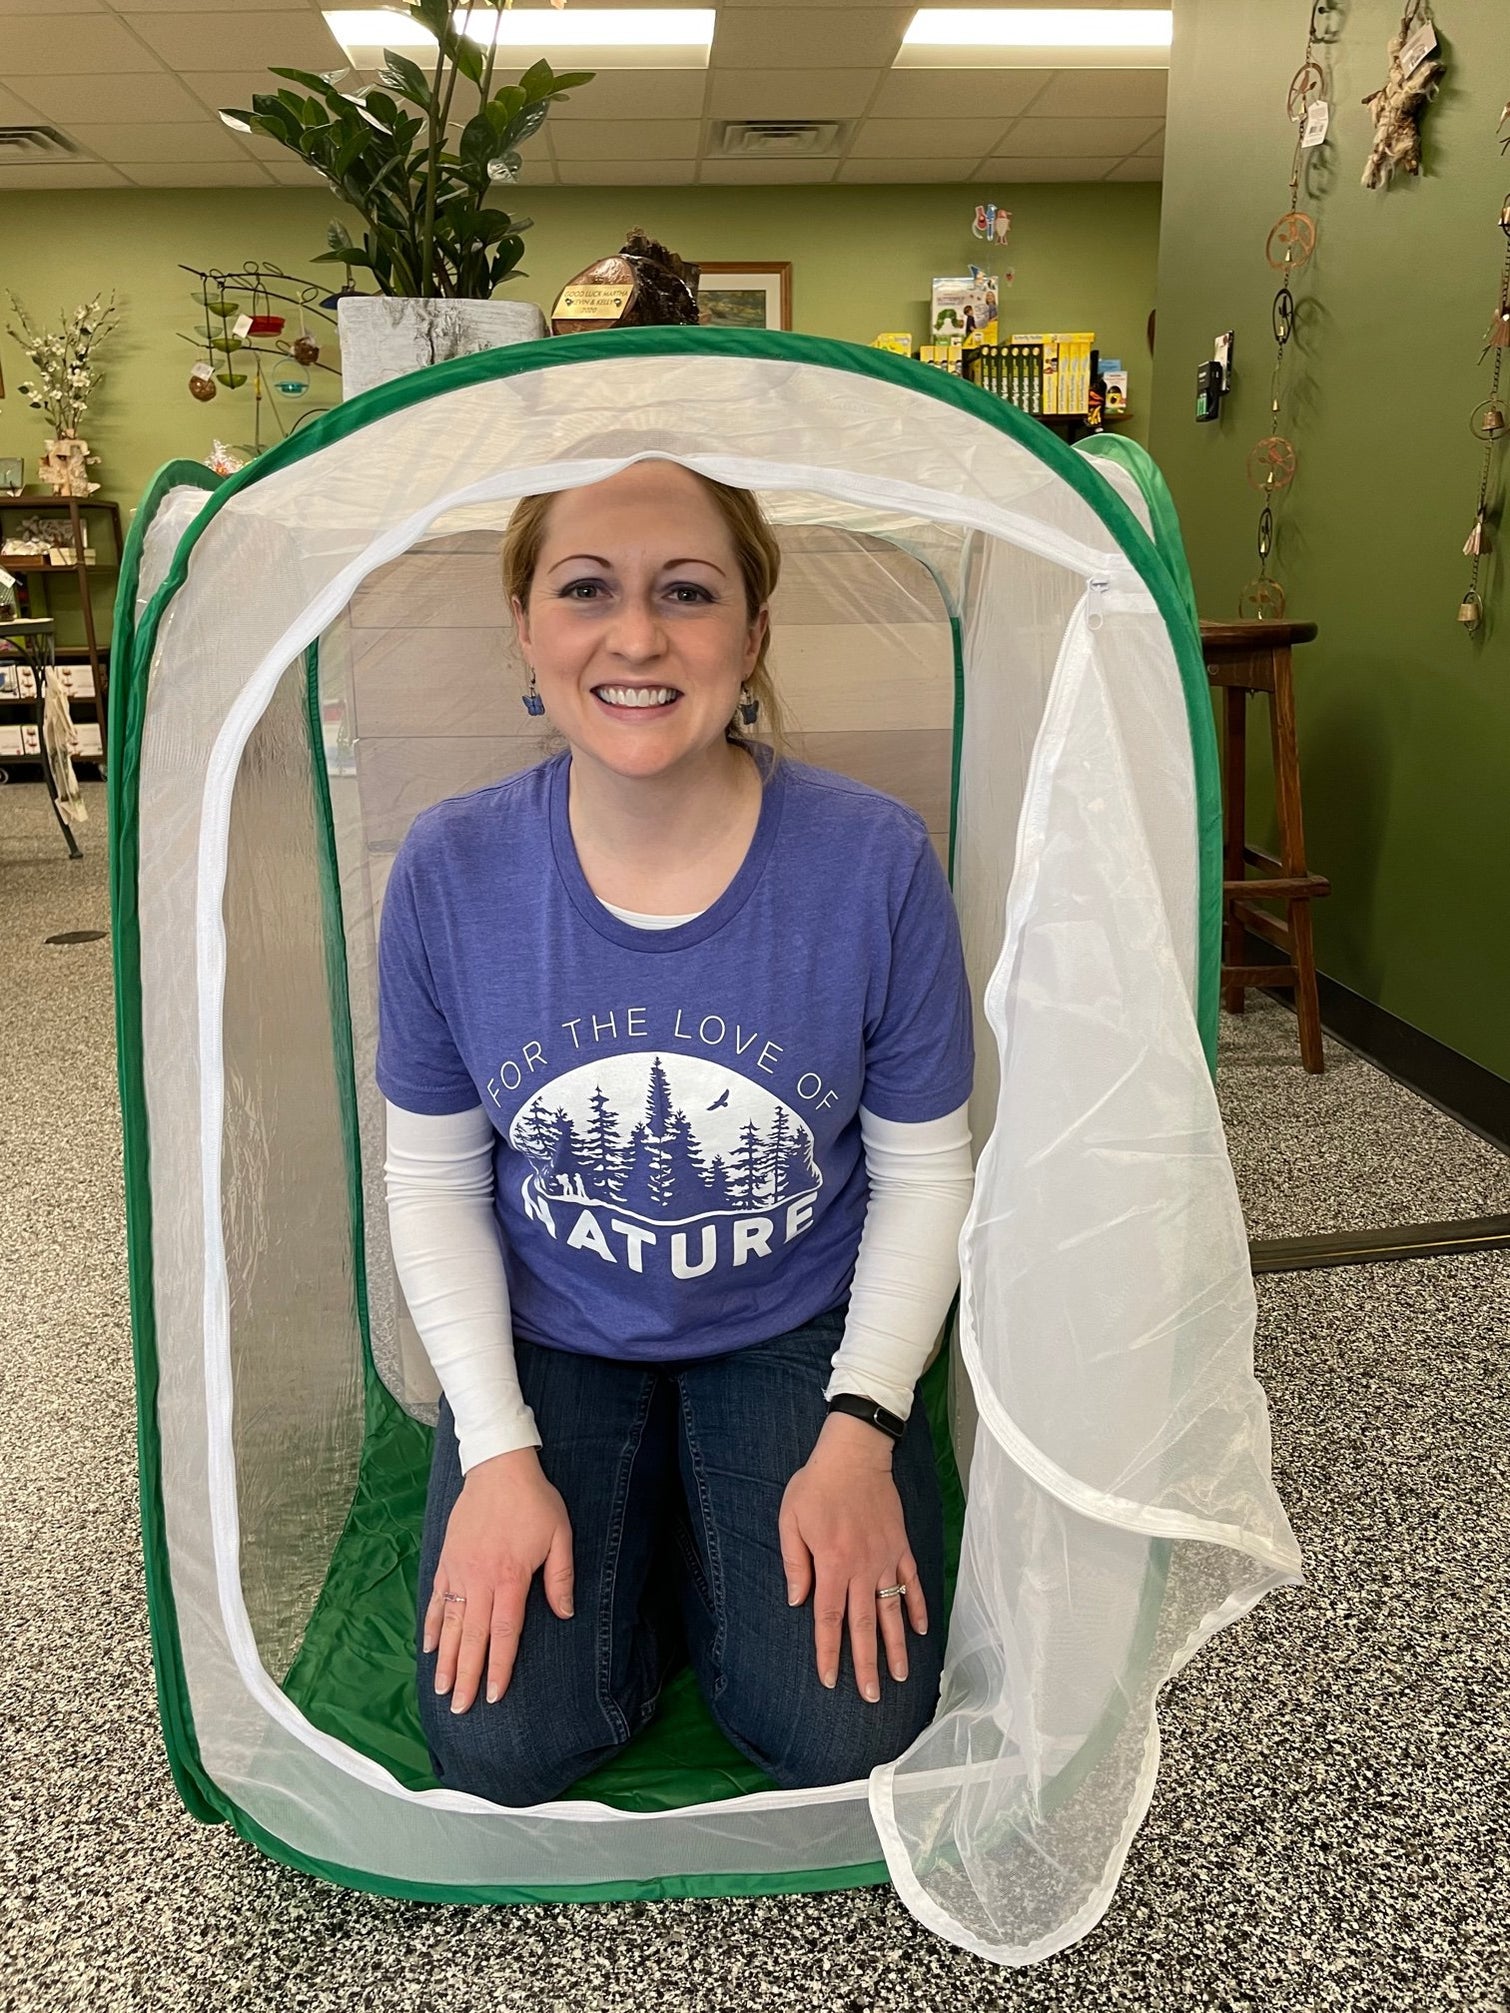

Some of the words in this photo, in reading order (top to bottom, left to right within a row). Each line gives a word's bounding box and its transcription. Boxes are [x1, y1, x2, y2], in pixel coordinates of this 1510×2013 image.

[487, 1040, 548, 1108] FOR
[561, 1007, 648, 1048] THE
[674, 1009, 784, 1074] LOVE
[796, 1072, 838, 1111] OF
[520, 1173, 818, 1280] NATURE
